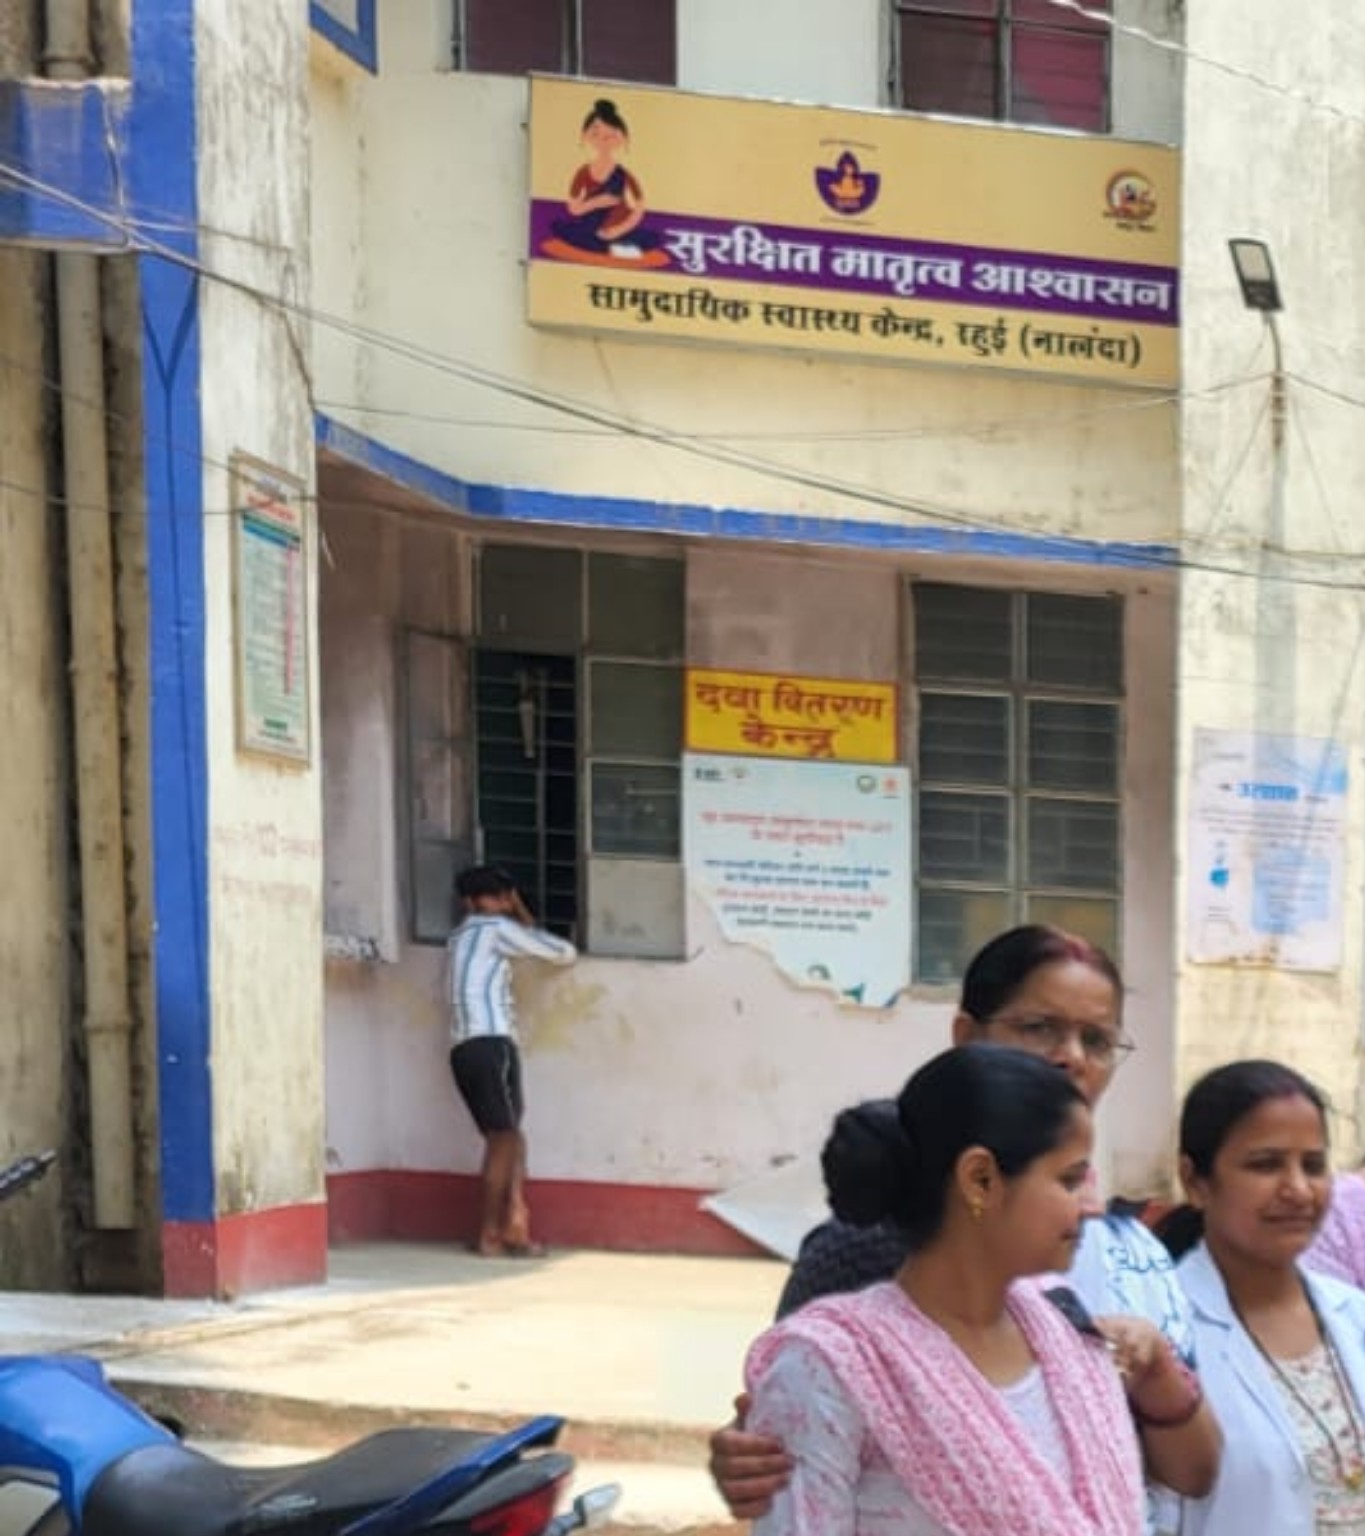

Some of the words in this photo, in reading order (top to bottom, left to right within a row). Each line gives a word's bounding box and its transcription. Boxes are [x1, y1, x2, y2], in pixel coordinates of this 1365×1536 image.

[664, 225, 823, 273] सुरक्षित
[831, 246, 963, 295] मातृत्व
[972, 261, 1171, 310] आश्वासन
[587, 283, 750, 322] सामुदायिक
[956, 317, 1008, 356] रहुई
[1020, 323, 1141, 368] (नालंदा)
